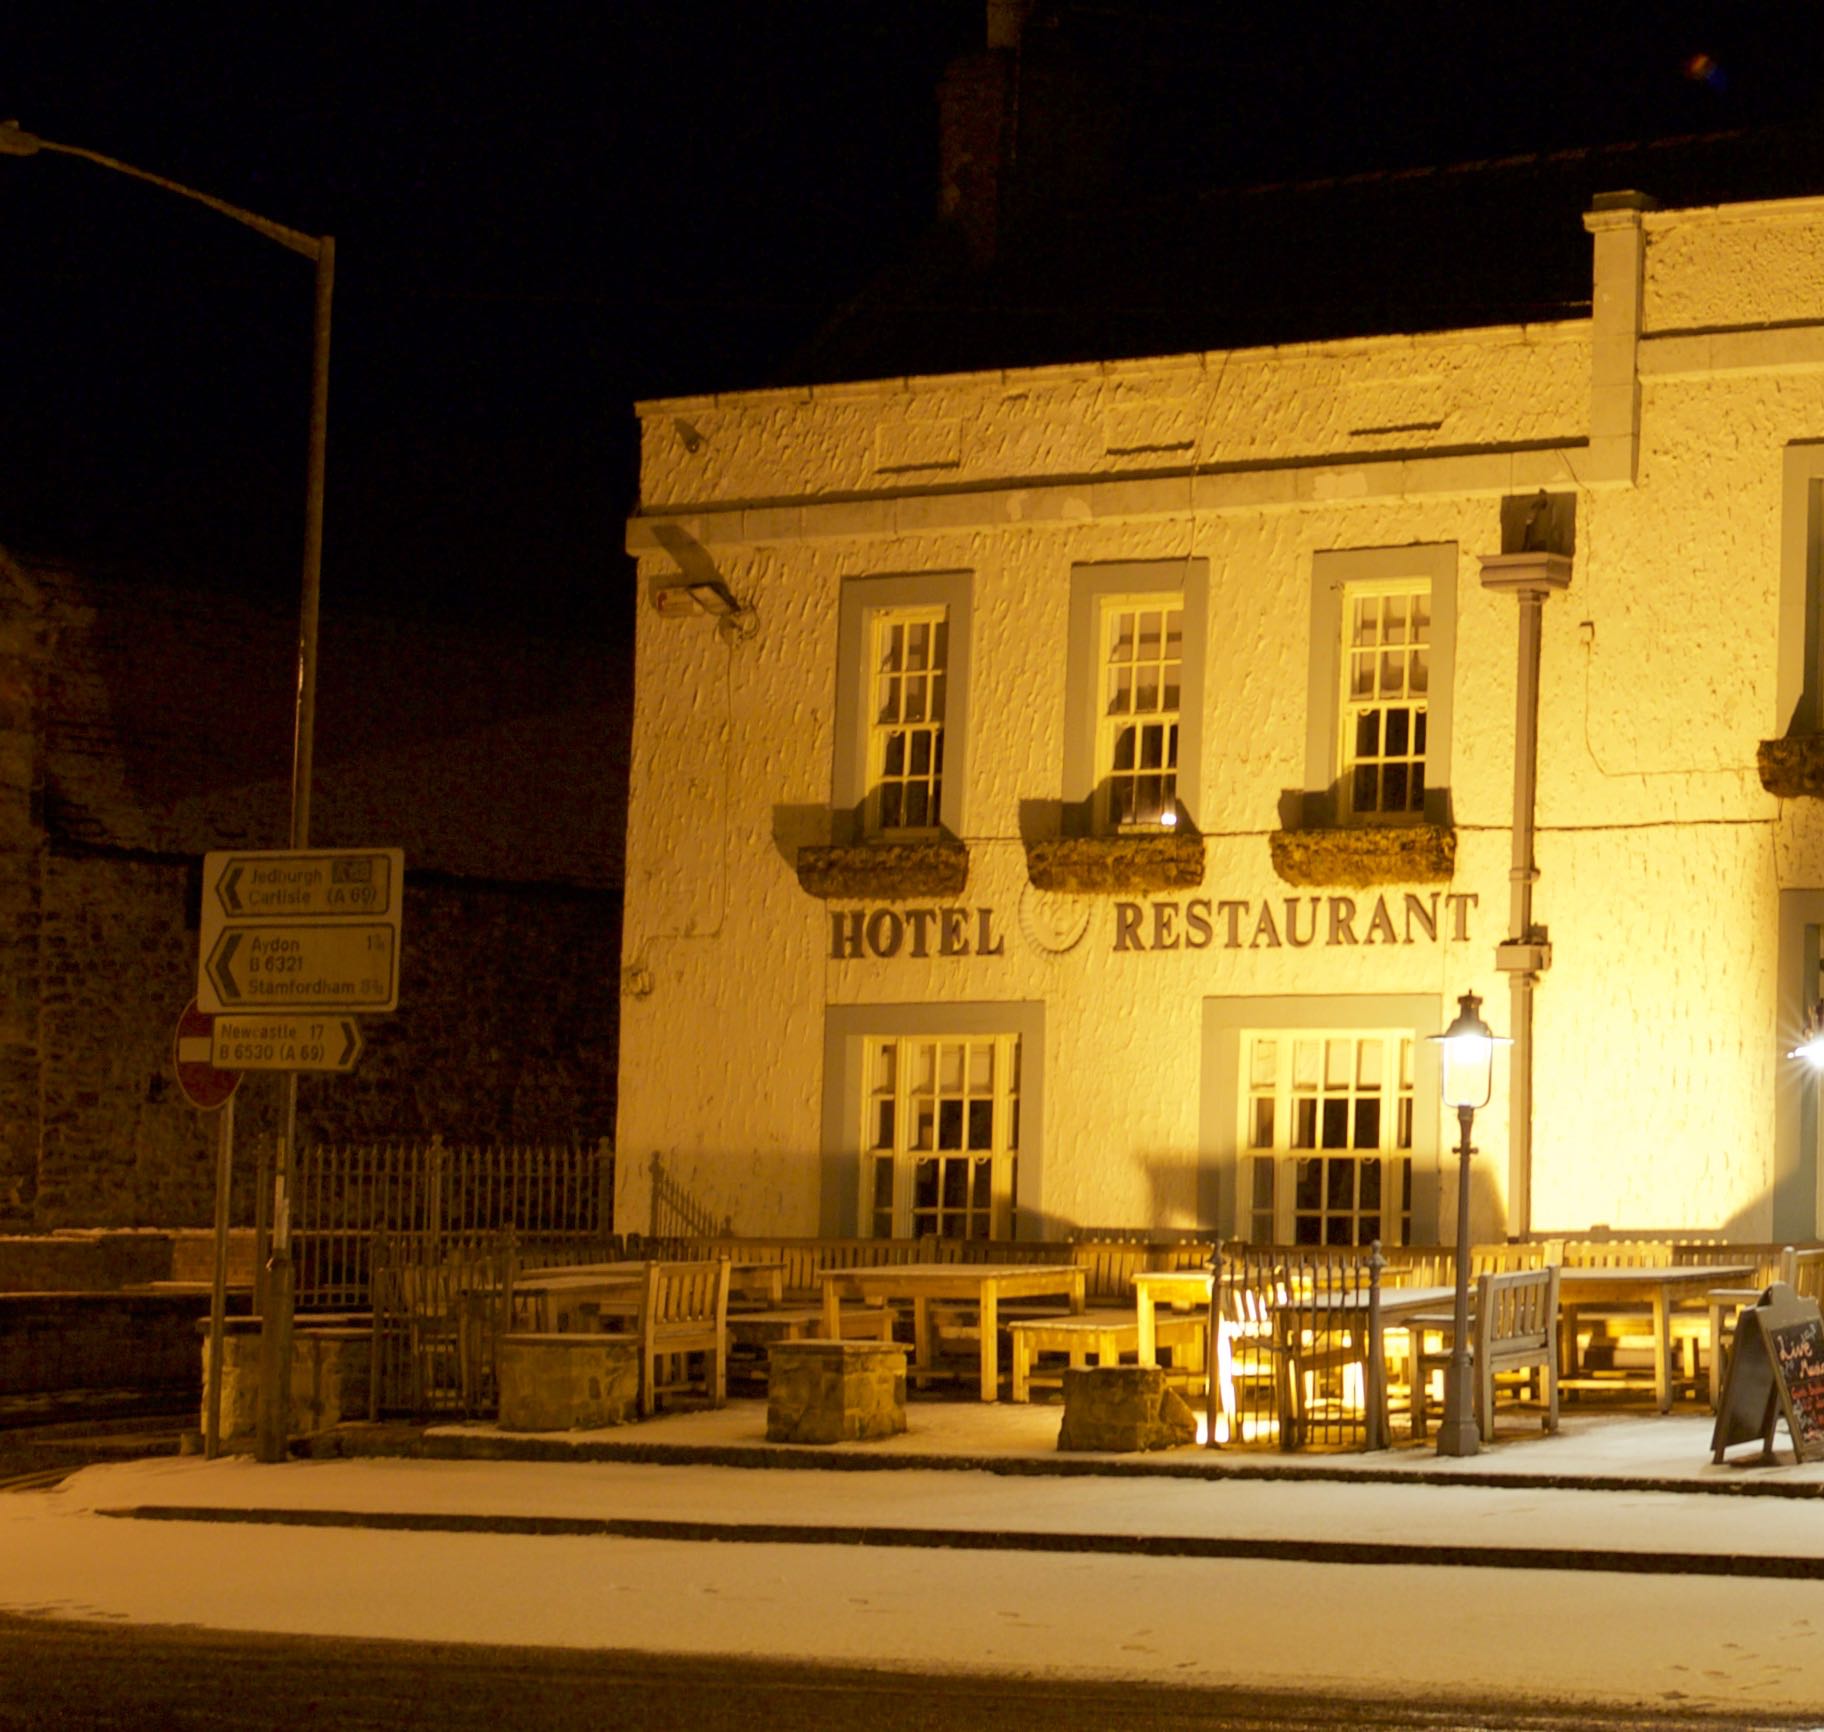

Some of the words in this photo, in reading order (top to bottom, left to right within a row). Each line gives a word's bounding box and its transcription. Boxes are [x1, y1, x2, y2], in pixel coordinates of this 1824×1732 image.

[249, 867, 323, 887] Jedburgh
[248, 890, 312, 906] Carlisle
[829, 906, 1005, 960] HOTEL
[1112, 893, 1480, 953] RESTAURANT
[251, 935, 301, 955] Aydon
[249, 957, 261, 973] B
[264, 956, 303, 973] 6321
[247, 978, 356, 996] Stamfordham
[220, 1022, 298, 1040] Newcastle
[310, 1022, 325, 1040] 17
[220, 1045, 230, 1061] B
[233, 1044, 273, 1061] 6530
[1776, 1335, 1814, 1361] Live
